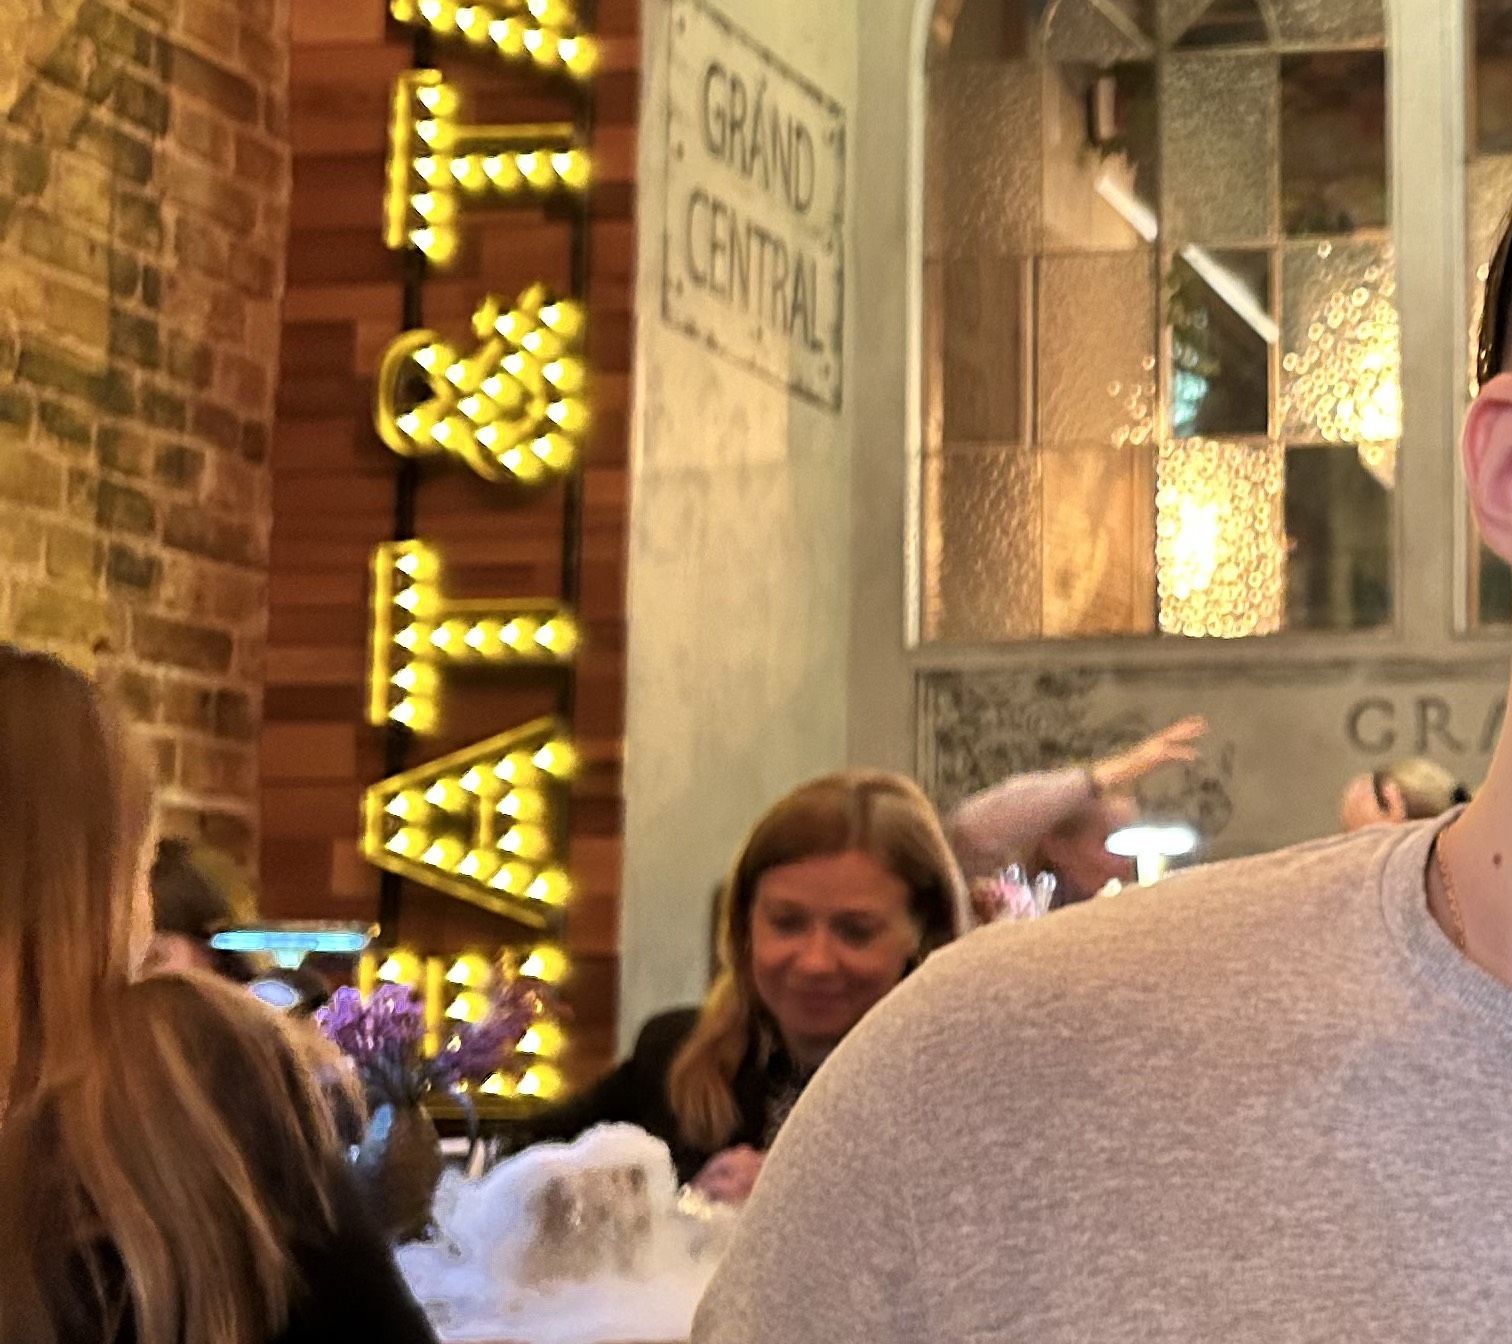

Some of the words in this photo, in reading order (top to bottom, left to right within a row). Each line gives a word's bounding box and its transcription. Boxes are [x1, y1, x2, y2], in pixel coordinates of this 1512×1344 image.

[702, 59, 817, 216] GRAND
[685, 188, 824, 354] CENTRAL
[374, 282, 590, 486] &
